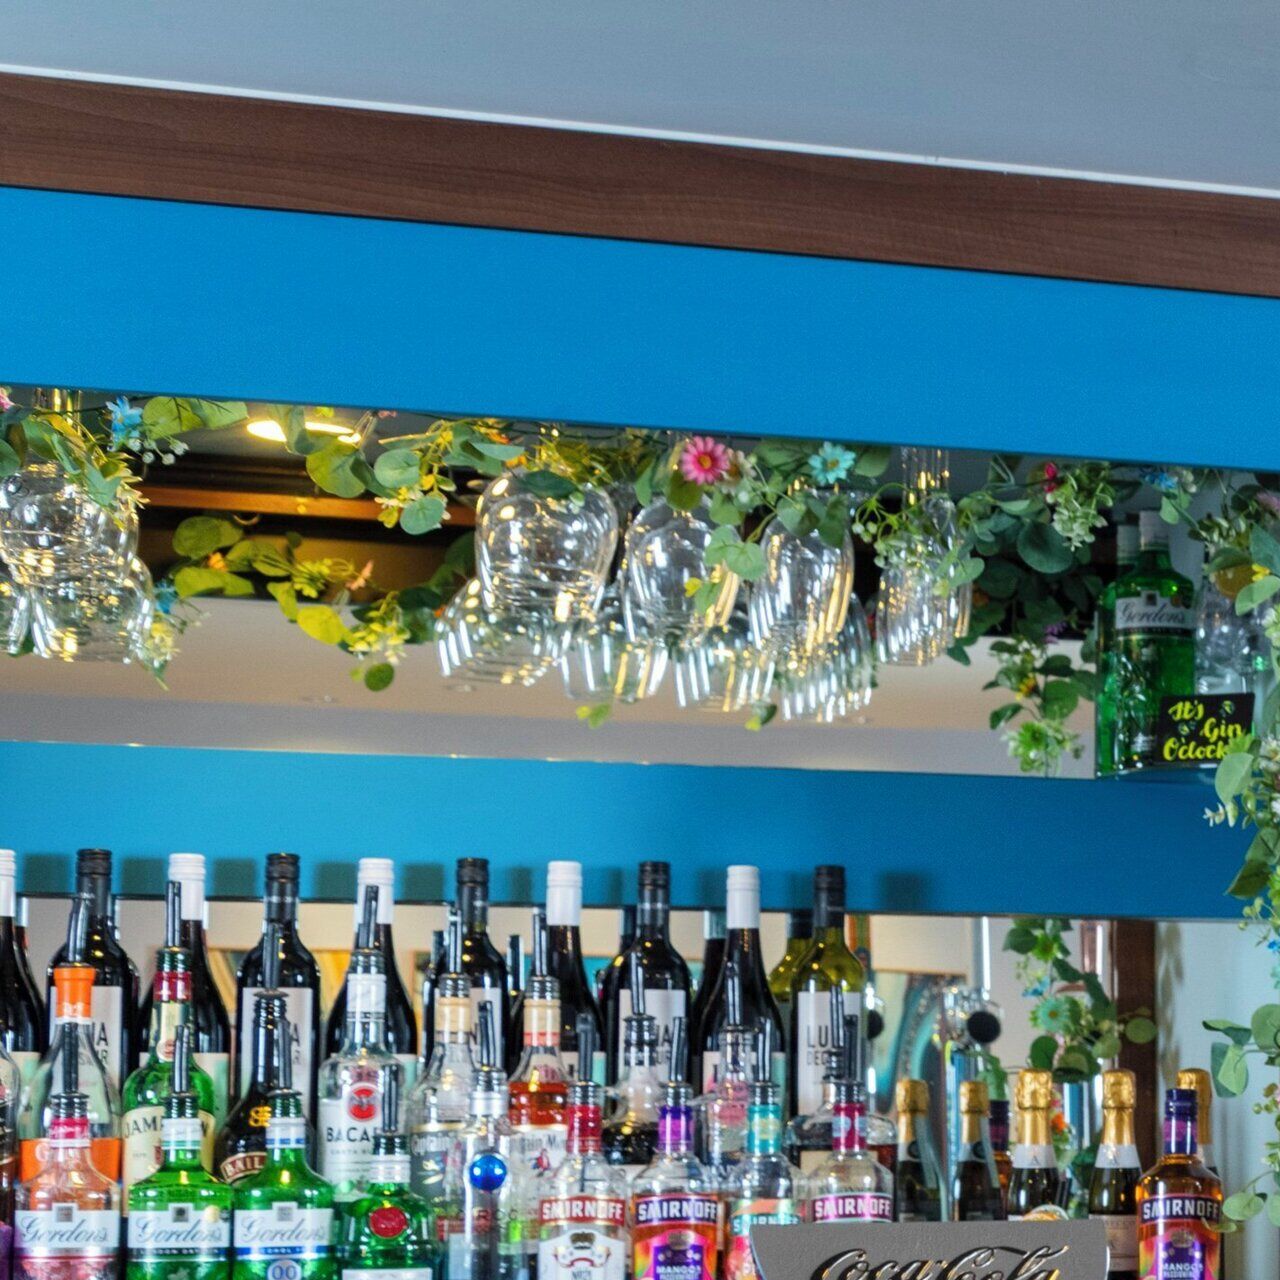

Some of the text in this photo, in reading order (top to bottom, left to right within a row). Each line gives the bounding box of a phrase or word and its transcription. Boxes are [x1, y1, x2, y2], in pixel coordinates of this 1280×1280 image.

[1168, 700, 1204, 721] It's
[1200, 717, 1243, 742] Gin
[125, 1116, 208, 1139] JAMN
[326, 1127, 376, 1142] BACA
[221, 1155, 266, 1178] BAIL
[542, 1201, 623, 1220] SMIRNOFF
[638, 1201, 718, 1221] SMIRNOFF
[814, 1197, 891, 1218] SMIRNOFF
[1143, 1199, 1219, 1219] SMIRNOFF
